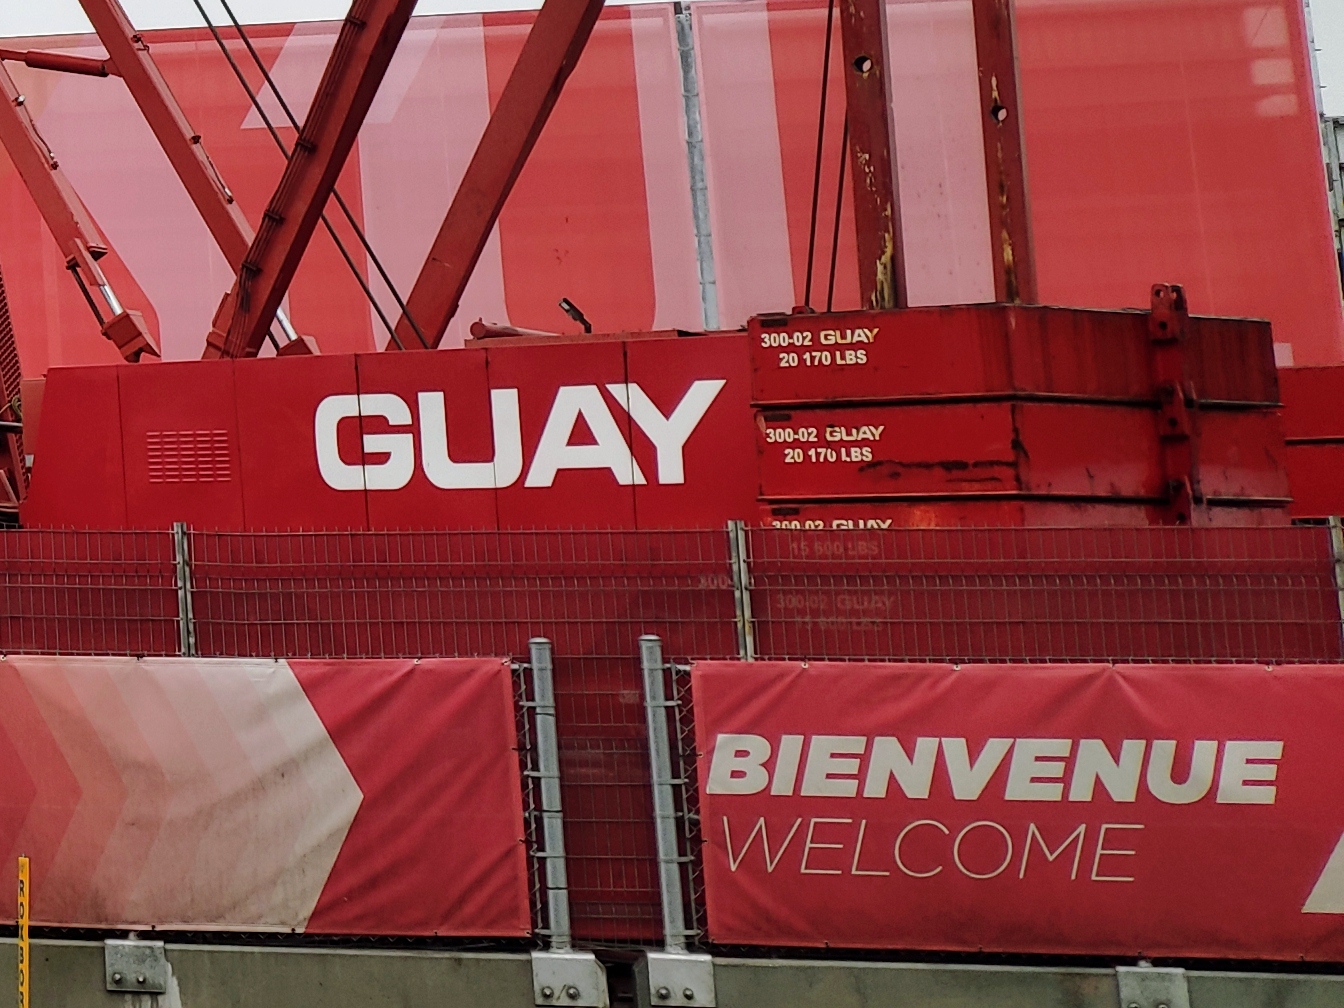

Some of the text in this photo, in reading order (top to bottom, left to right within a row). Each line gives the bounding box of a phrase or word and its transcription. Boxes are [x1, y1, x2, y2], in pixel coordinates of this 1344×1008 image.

[761, 327, 880, 348] 300-02 GUAY
[779, 349, 867, 368] 20 170 LBS
[314, 379, 728, 491] GUAY
[765, 425, 885, 443] 300-02 GUAY
[784, 446, 873, 463] 20 170 LBS
[705, 733, 1284, 805] BIENVENUE
[720, 815, 1146, 883] WELCOME
